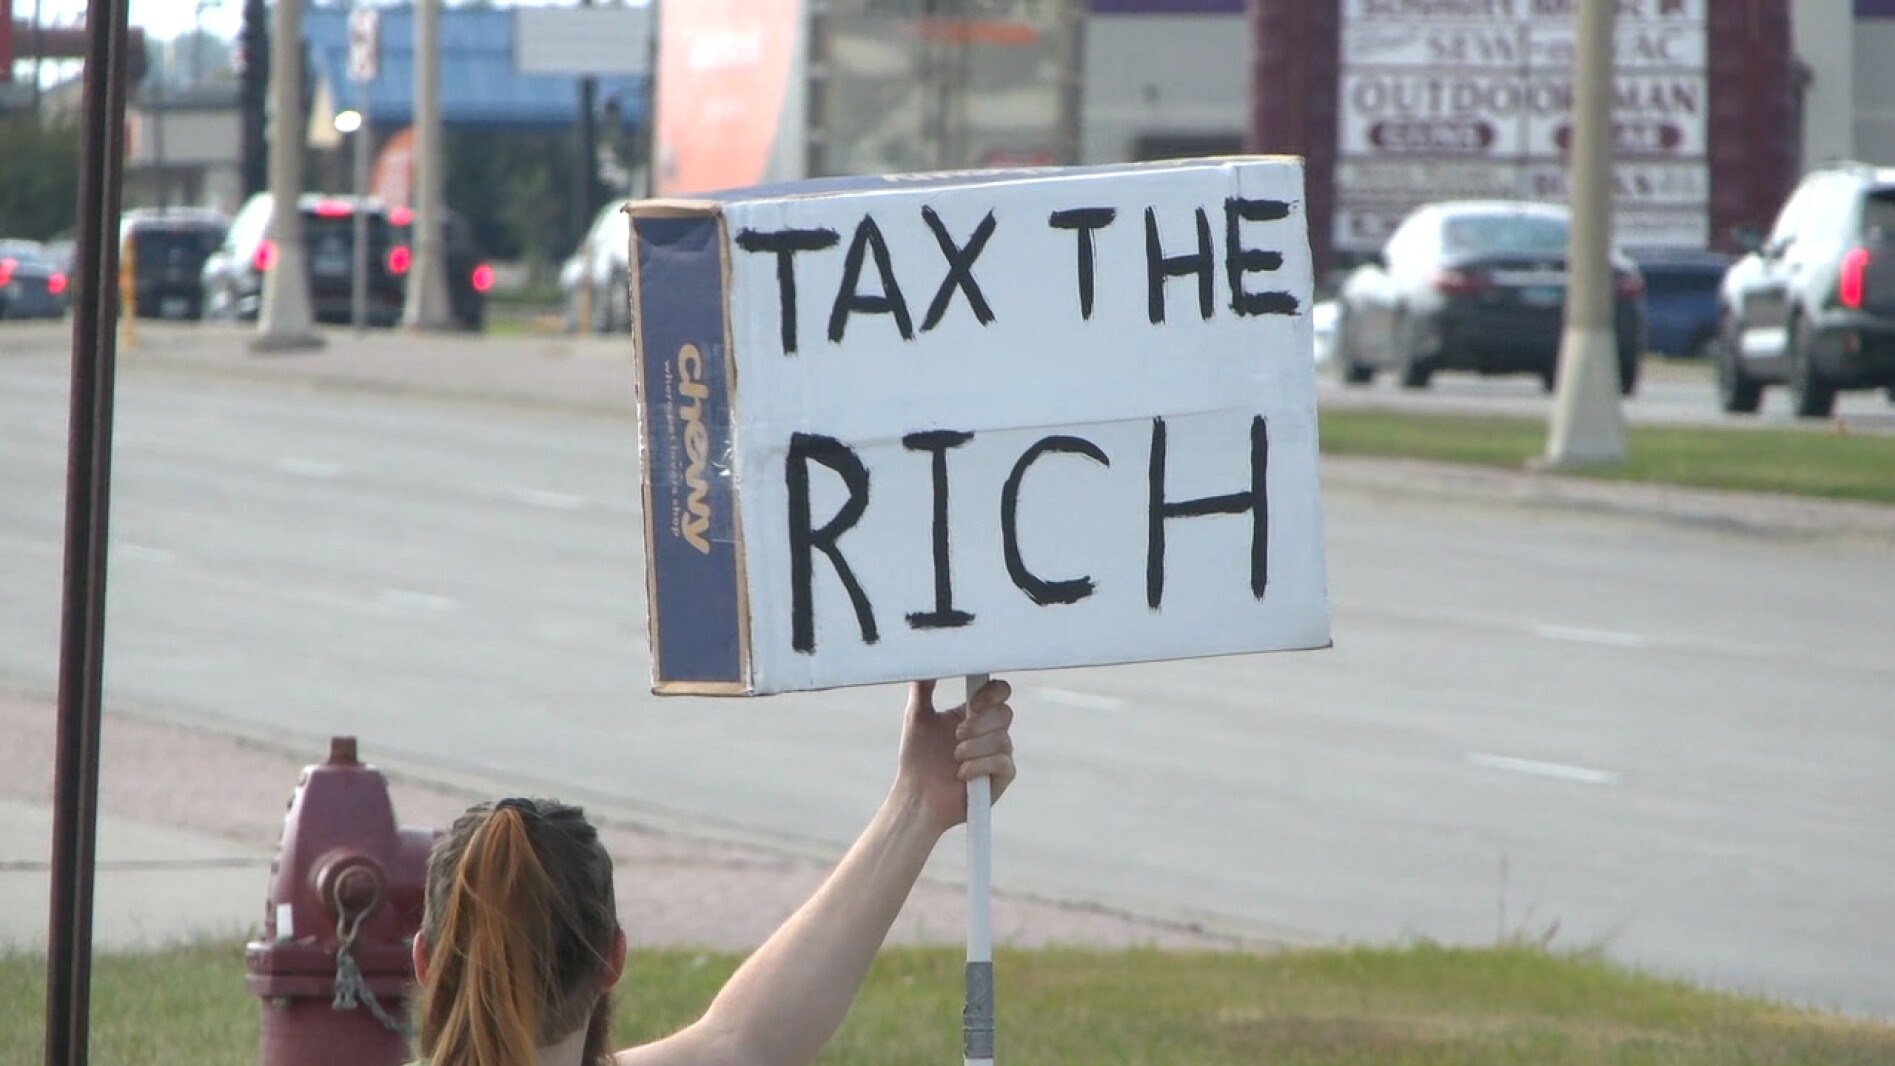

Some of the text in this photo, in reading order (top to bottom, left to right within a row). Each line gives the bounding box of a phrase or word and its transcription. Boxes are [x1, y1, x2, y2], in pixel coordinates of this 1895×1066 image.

[735, 197, 1300, 355] TAX THE
[671, 499, 681, 538] shop
[677, 343, 711, 555] chewy
[785, 414, 1269, 655] RICH
